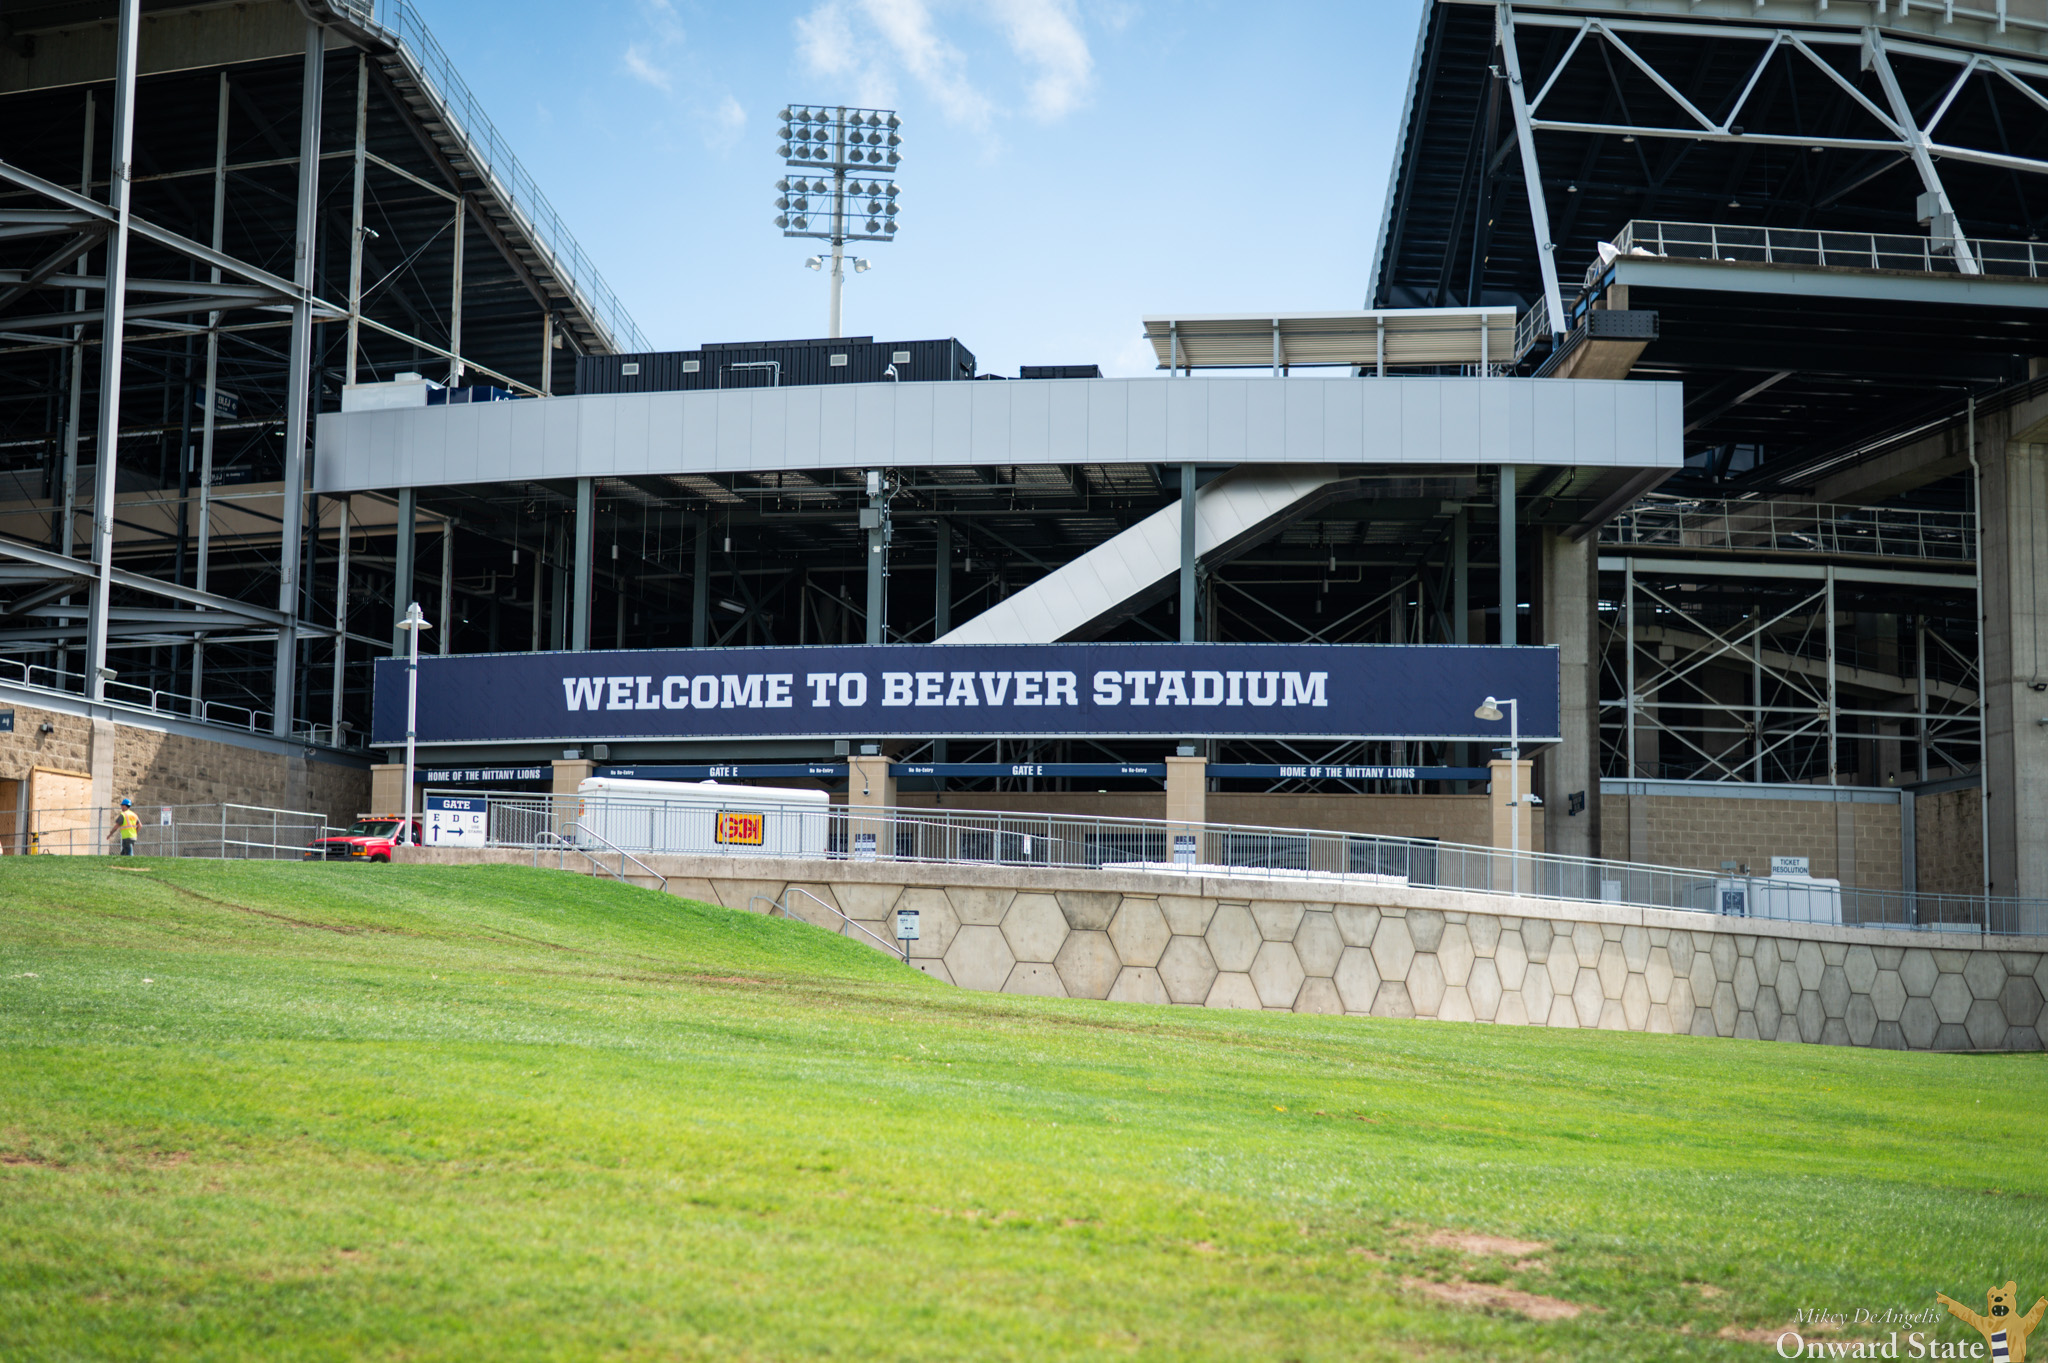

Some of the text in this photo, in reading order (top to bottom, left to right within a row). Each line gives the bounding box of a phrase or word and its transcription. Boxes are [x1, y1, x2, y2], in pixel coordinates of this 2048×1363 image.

[563, 671, 1329, 711] WELCOME TO BEAVER STADIUM
[427, 769, 541, 781] HOME OF THE NITTANY LIONS
[709, 767, 738, 777] GATE E
[1012, 766, 1043, 775] GATE E
[1279, 767, 1415, 778] HOME OF THE NITTANY LIONS
[443, 799, 471, 810] GATE
[433, 813, 479, 823] E D C
[1772, 866, 1808, 874] RESOLUTION
